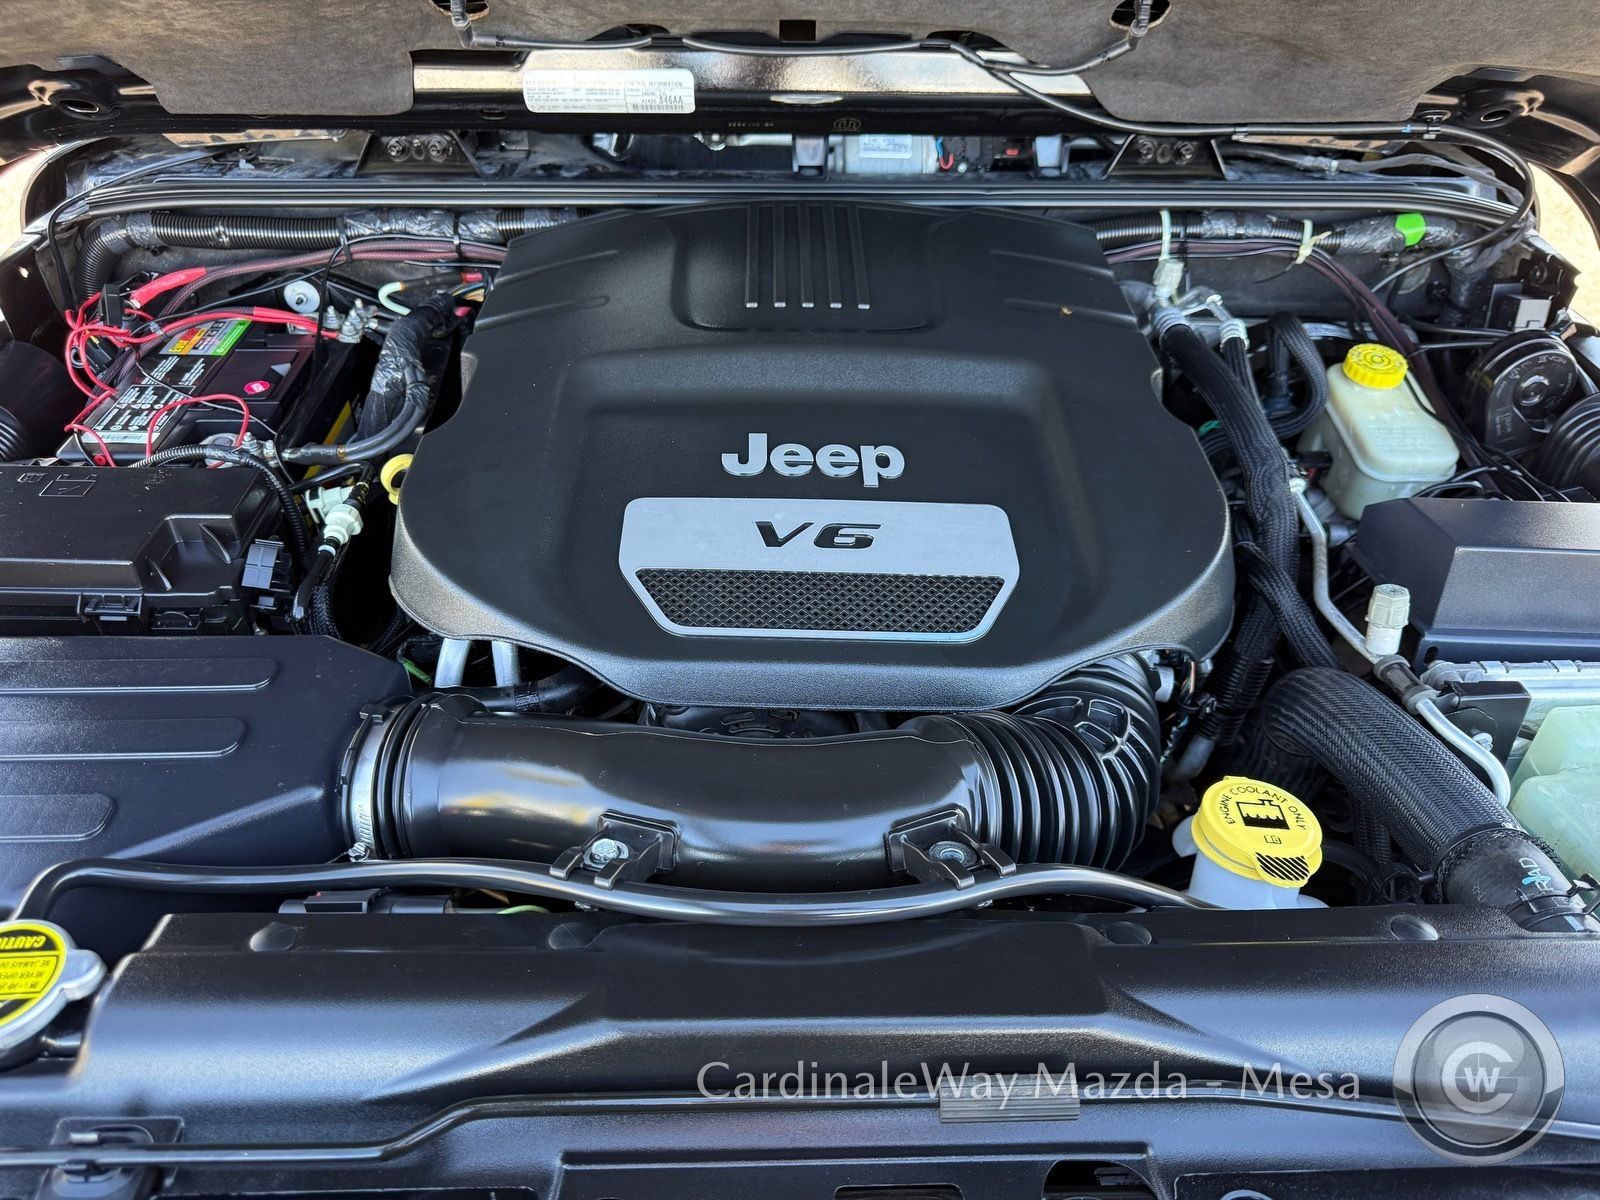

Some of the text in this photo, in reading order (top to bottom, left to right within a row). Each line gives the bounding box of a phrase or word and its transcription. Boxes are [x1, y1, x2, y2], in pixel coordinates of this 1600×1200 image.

[721, 432, 905, 488] Jeep
[753, 520, 884, 549] V6
[1219, 785, 1307, 831] ENGINE COOLANT ONLY
